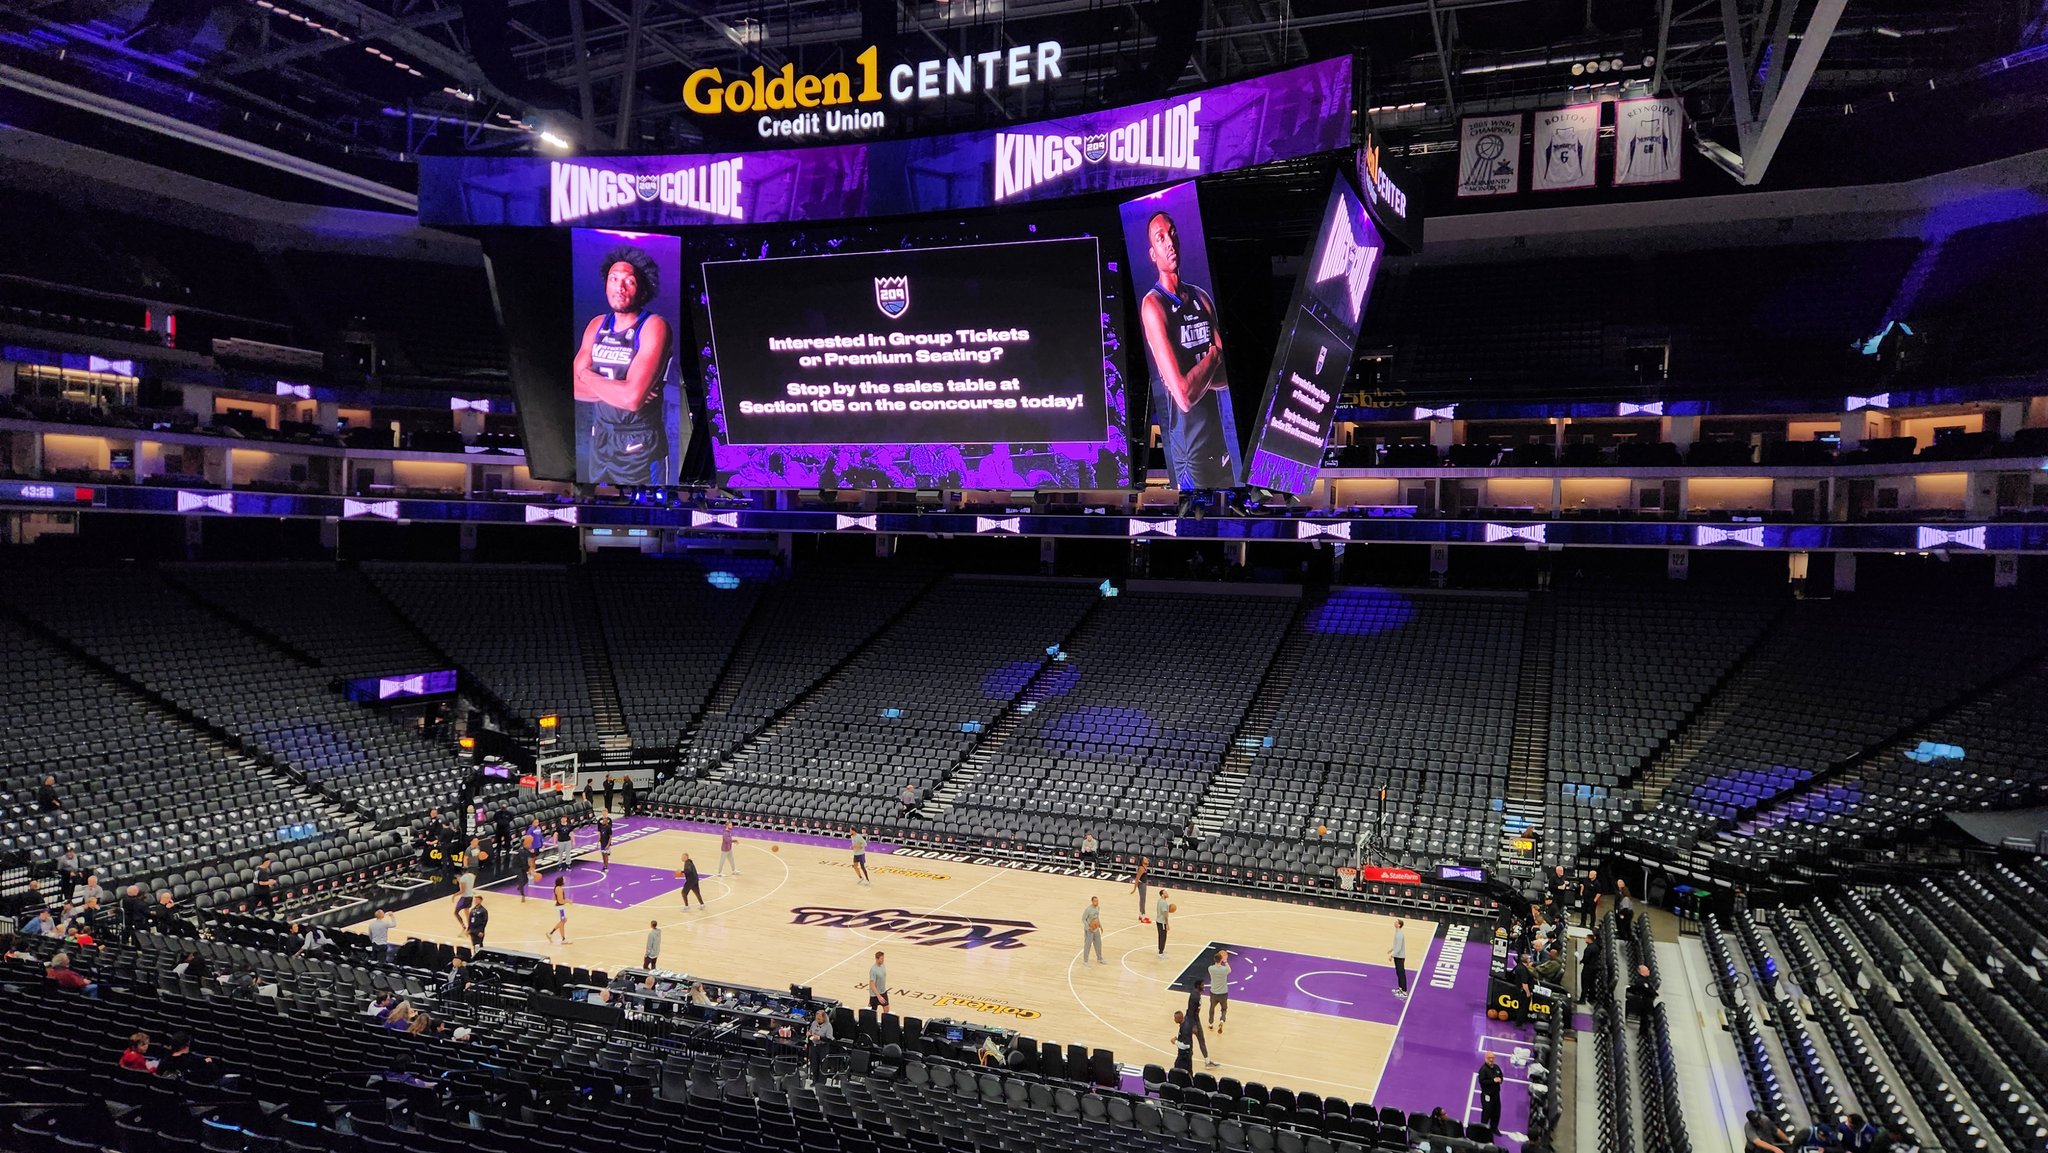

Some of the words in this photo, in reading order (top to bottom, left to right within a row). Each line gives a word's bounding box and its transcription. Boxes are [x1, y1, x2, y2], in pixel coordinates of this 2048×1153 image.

[888, 40, 1063, 101] CENTER
[1544, 114, 1587, 126] BOLTON
[1627, 105, 1675, 119] REYNOLDS
[757, 115, 820, 138] Credit
[826, 109, 885, 131] Union
[1468, 121, 1488, 130] 2005
[1491, 120, 1515, 128] WNBA
[1470, 127, 1513, 136] CHAMPION
[994, 133, 1082, 201] KINGS
[1087, 142, 1105, 151] 209
[1110, 96, 1202, 171] COLLIDE
[1560, 151, 1569, 164] 6
[550, 160, 636, 224] KINGS
[660, 156, 743, 219] COLLIDE
[1377, 166, 1407, 218] CENTER
[880, 288, 904, 300] 209
[769, 334, 865, 350] Interested
[868, 333, 885, 347] in
[889, 331, 953, 348] Group
[956, 328, 1030, 344] Tickets
[799, 355, 822, 367] or
[825, 351, 913, 366] Premium
[915, 346, 1004, 364] Seating?
[787, 382, 831, 398] Stop
[833, 382, 856, 398] by
[859, 381, 891, 395] the
[893, 380, 944, 393] sales
[947, 378, 996, 392] table
[1000, 377, 1020, 391] at
[739, 399, 808, 414] Section
[810, 399, 844, 413] 105
[847, 400, 872, 412] on
[875, 398, 907, 412] the
[909, 397, 1017, 412] concourse
[1020, 394, 1084, 411] today!
[20, 486, 54, 498] 43:28
[178, 490, 202, 513] KINGS
[208, 493, 233, 514] COLLIDE
[344, 498, 366, 517] KINGS
[525, 505, 548, 524] KINGS
[553, 506, 577, 524] COLLIDE
[692, 510, 713, 528] KINGS
[717, 511, 738, 528] COLLIDE
[836, 514, 854, 531] KINGS
[859, 514, 877, 531] COLLIDE
[977, 516, 996, 534] KINGS
[1000, 516, 1020, 534] COLLIDE
[1129, 518, 1151, 536] KINGS
[1155, 519, 1177, 537] COLLIDE
[1298, 520, 1321, 539] KINGS
[1327, 521, 1351, 540] COLLIDE
[1486, 522, 1513, 543] KINGS
[1519, 523, 1546, 543] COLLIDE
[1697, 525, 1727, 546] KINGS
[1734, 526, 1764, 547] COLLIDE
[1919, 526, 1946, 549] KINGS
[1956, 526, 1986, 550] COLLIDE
[1672, 553, 1685, 566] 122
[893, 848, 971, 863] PROUD
[972, 856, 1141, 883] ACRAMENTO
[789, 906, 1038, 949] Kings
[933, 995, 1041, 1020] Golden1
